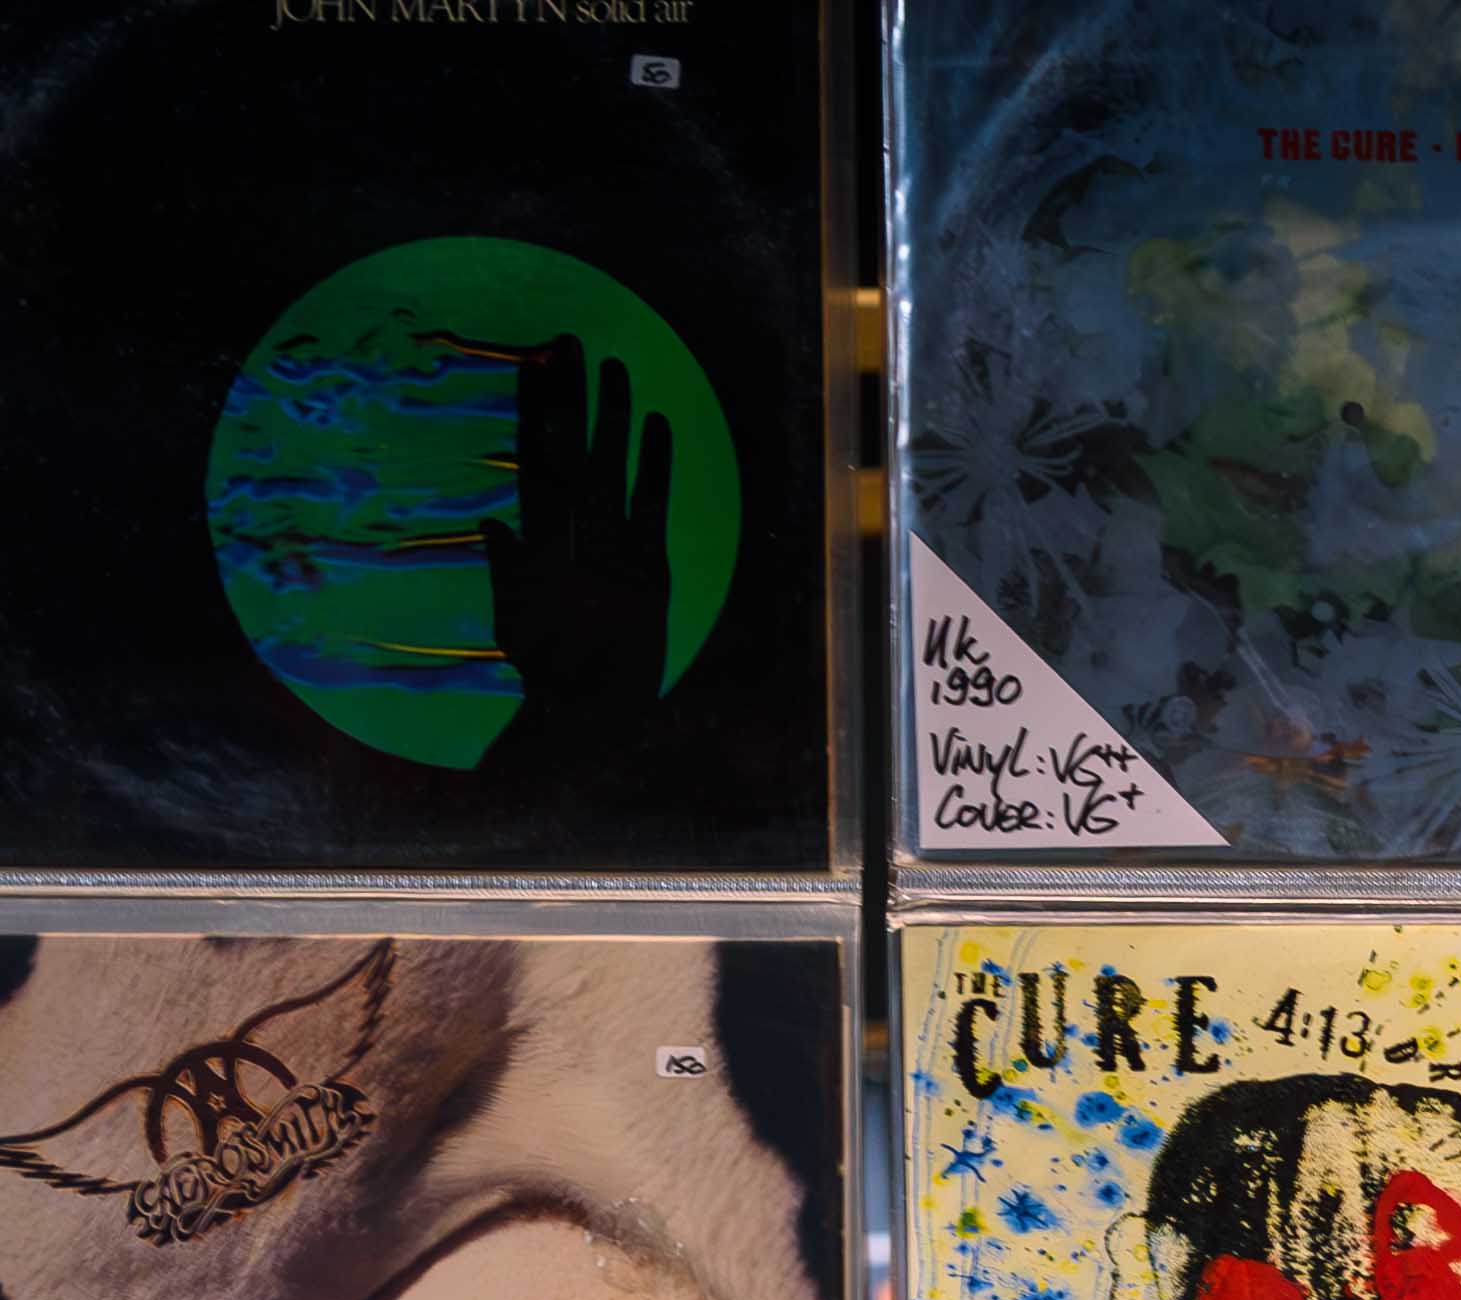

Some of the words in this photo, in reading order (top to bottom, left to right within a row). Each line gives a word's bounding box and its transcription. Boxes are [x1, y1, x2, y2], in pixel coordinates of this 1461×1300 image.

[1257, 127, 1321, 161] THE
[1331, 128, 1418, 163] CURE
[930, 666, 1023, 708] 1990
[953, 972, 1220, 1100] CURE
